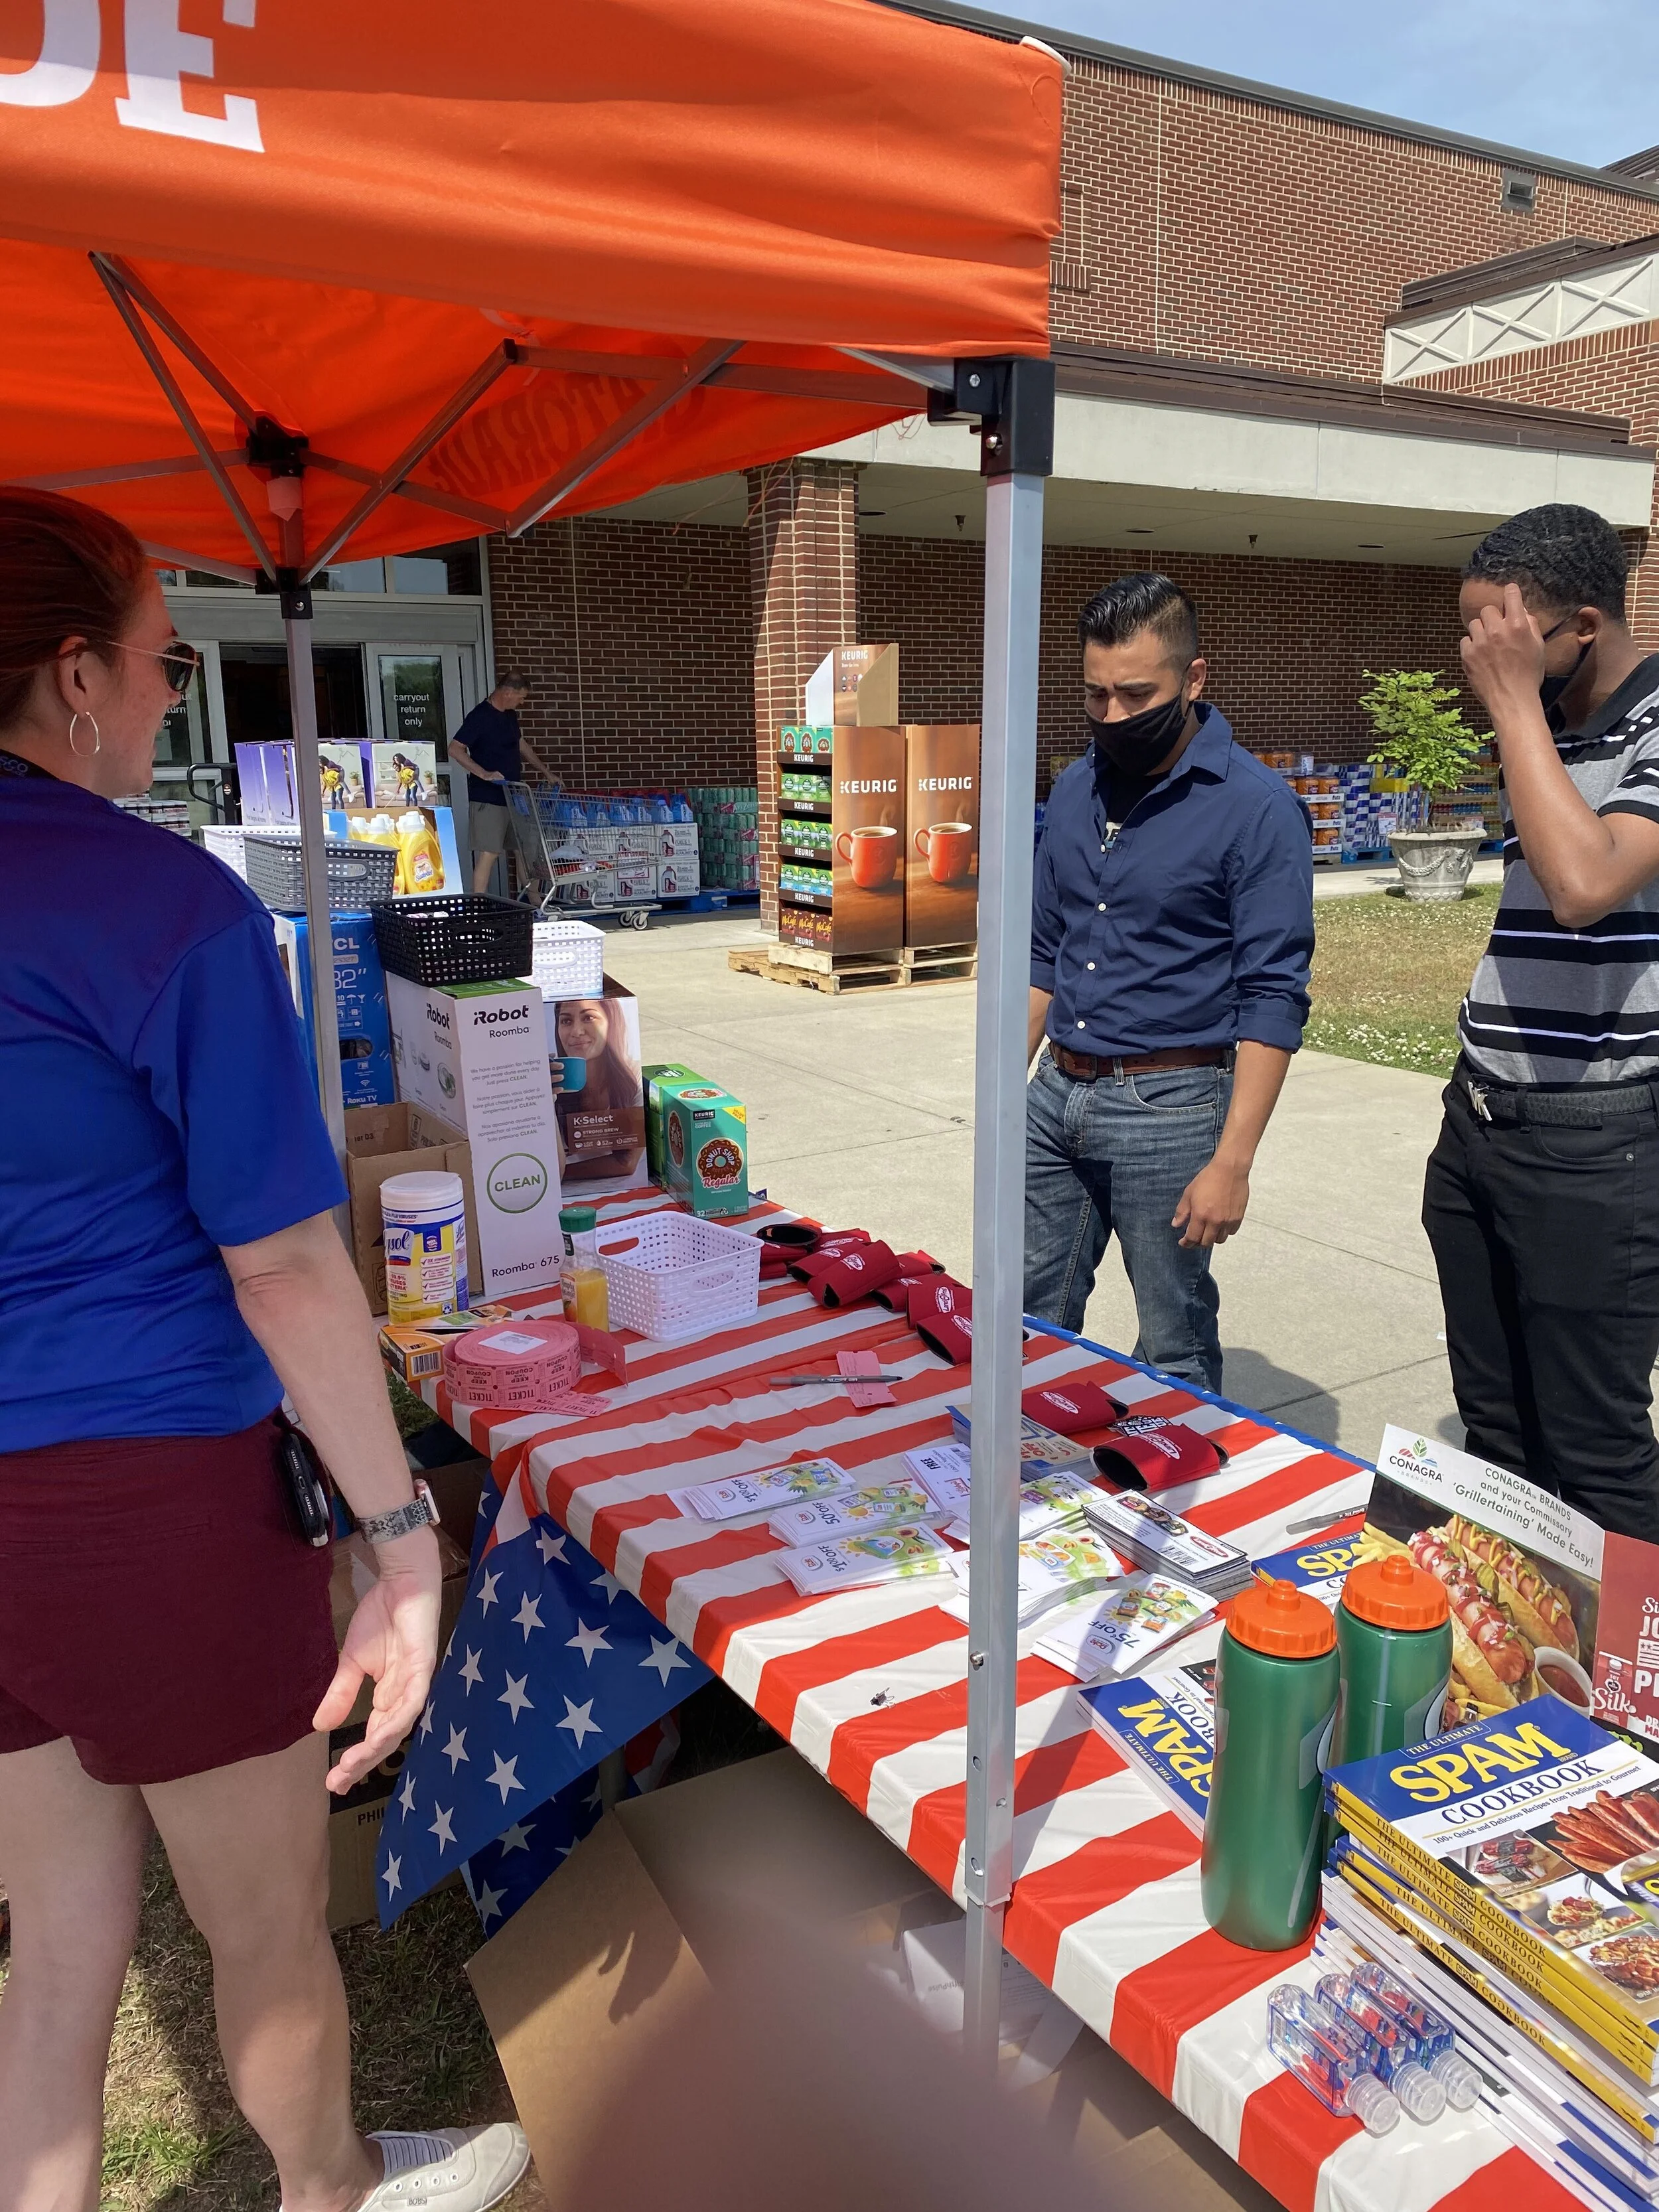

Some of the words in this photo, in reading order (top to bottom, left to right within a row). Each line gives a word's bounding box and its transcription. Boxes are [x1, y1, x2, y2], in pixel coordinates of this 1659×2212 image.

[841, 650, 868, 660] KEURIG
[394, 694, 429, 702] carryout
[405, 717, 422, 727] only
[840, 779, 897, 794] KEURIG
[918, 776, 972, 791] KEURIG
[794, 802, 814, 810] KEURIG
[795, 848, 814, 857] KEURIG
[795, 893, 814, 903] KEURIG
[795, 936, 814, 946] KEURIG
[426, 1003, 451, 1030] iRobot
[474, 1005, 529, 1025] iRobot
[489, 1026, 530, 1038] Roomba
[434, 1031, 453, 1050] Roomba
[706, 1147, 721, 1168] DONUT
[722, 1148, 735, 1166] SHOP
[494, 1173, 541, 1193] CLEAN
[703, 1174, 741, 1189] Regular
[491, 1261, 534, 1278] Roomba
[540, 1255, 560, 1268] 675
[546, 1355, 567, 1367] COUPON
[505, 1367, 534, 1376] COUPON
[551, 1364, 565, 1374] KEEP
[548, 1377, 569, 1392] TICKET
[469, 1392, 493, 1402] TICKET
[508, 1389, 535, 1401] TICKET
[920, 1457, 941, 1469] FREE
[1390, 1454, 1444, 1483] CONAGRA
[731, 1479, 748, 1489] OFF
[1402, 1471, 1428, 1485] BRANDS
[812, 1502, 830, 1512] OFF
[1480, 1481, 1499, 1495] and
[1501, 1489, 1522, 1507] your
[1524, 1499, 1573, 1536] Commissary
[1540, 1493, 1571, 1520] BRANDS
[1313, 1542, 1328, 1550] THE
[1330, 1532, 1362, 1546] ULTIMA
[1537, 1522, 1566, 1548] Made
[1568, 1542, 1594, 1568] Easy!
[818, 1545, 837, 1557] OFF
[1297, 1548, 1354, 1578] SP
[1088, 1621, 1117, 1635] OFF
[1090, 1638, 1108, 1650] Dole
[1171, 1676, 1190, 1696] Gourmet
[1594, 1688, 1631, 1714] Silk
[1406, 1741, 1432, 1755] THE
[1433, 1725, 1483, 1748] ULTIMATE
[1124, 1733, 1159, 1769] ULTIMATE
[1558, 1752, 1579, 1761] BRAND
[1390, 1722, 1572, 1803] SPAM
[1158, 1765, 1174, 1781] THE
[1441, 1758, 1605, 1824] COOKBOOK
[1433, 1834, 1452, 1844] 100+
[1453, 1826, 1477, 1840] Quick
[1478, 1823, 1490, 1832] and
[1491, 1810, 1523, 1828] Delicious
[1524, 1800, 1550, 1818] Recipes
[1550, 1794, 1567, 1806] from
[1568, 1781, 1603, 1799] Traditional
[1611, 1765, 1642, 1783] Gourmet
[1376, 1816, 1395, 1838] THE
[1399, 1838, 1451, 1881] ULTIMATE
[1454, 1878, 1477, 1903] SPAM
[1480, 1901, 1547, 1958] COOKBOOK
[1378, 1830, 1398, 1850] THE
[1400, 1849, 1451, 1895] ULTIMATE
[1454, 1891, 1477, 1915] SPAM
[1480, 1914, 1544, 1972] COOKBOOK
[1376, 1844, 1396, 1866] THE
[1399, 1864, 1450, 1910] ULTIMATE
[1453, 1908, 1475, 1932] SPAM
[1479, 1931, 1543, 1989] COOKBOOK
[1395, 1885, 1417, 1906] THE
[1421, 1904, 1479, 1951] ULTIMATE
[1482, 1948, 1507, 1971] SPAM
[1380, 1897, 1400, 1918] THE
[1402, 1917, 1454, 1966] ULTIMATE
[1456, 1963, 1479, 1988] SPAM
[1481, 1991, 1547, 2045] COOKBOOK
